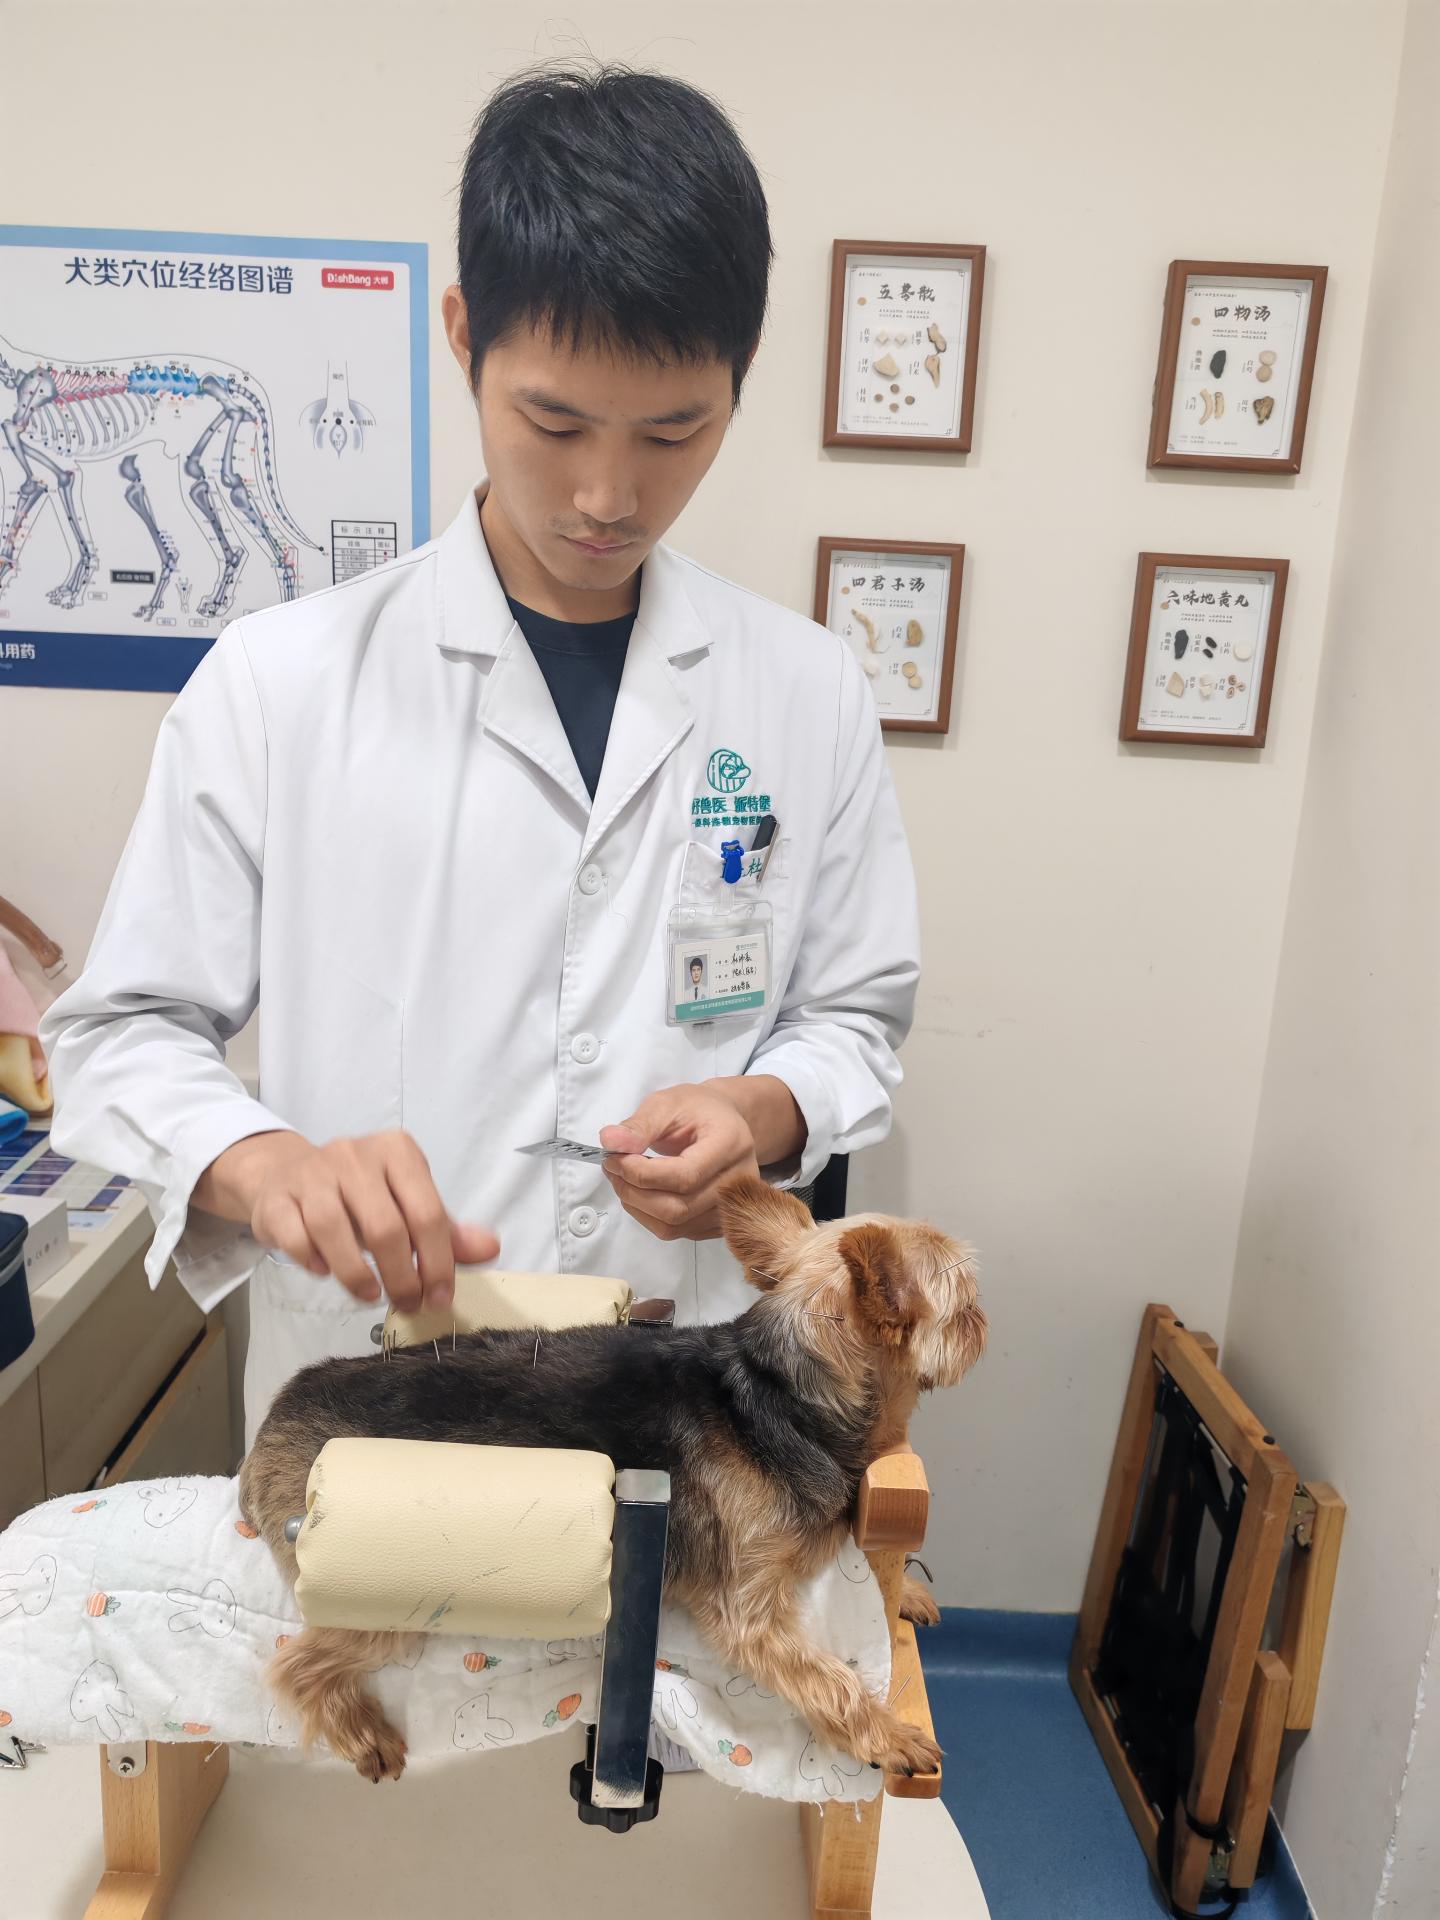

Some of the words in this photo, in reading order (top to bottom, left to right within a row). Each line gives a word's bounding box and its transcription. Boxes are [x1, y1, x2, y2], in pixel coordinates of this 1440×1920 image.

[64, 257, 294, 295] 犬类穴位经络图谱
[1214, 305, 1271, 322] 四物汤
[852, 575, 926, 593] 四君子汤
[1167, 589, 1250, 608] 六味地黄丸
